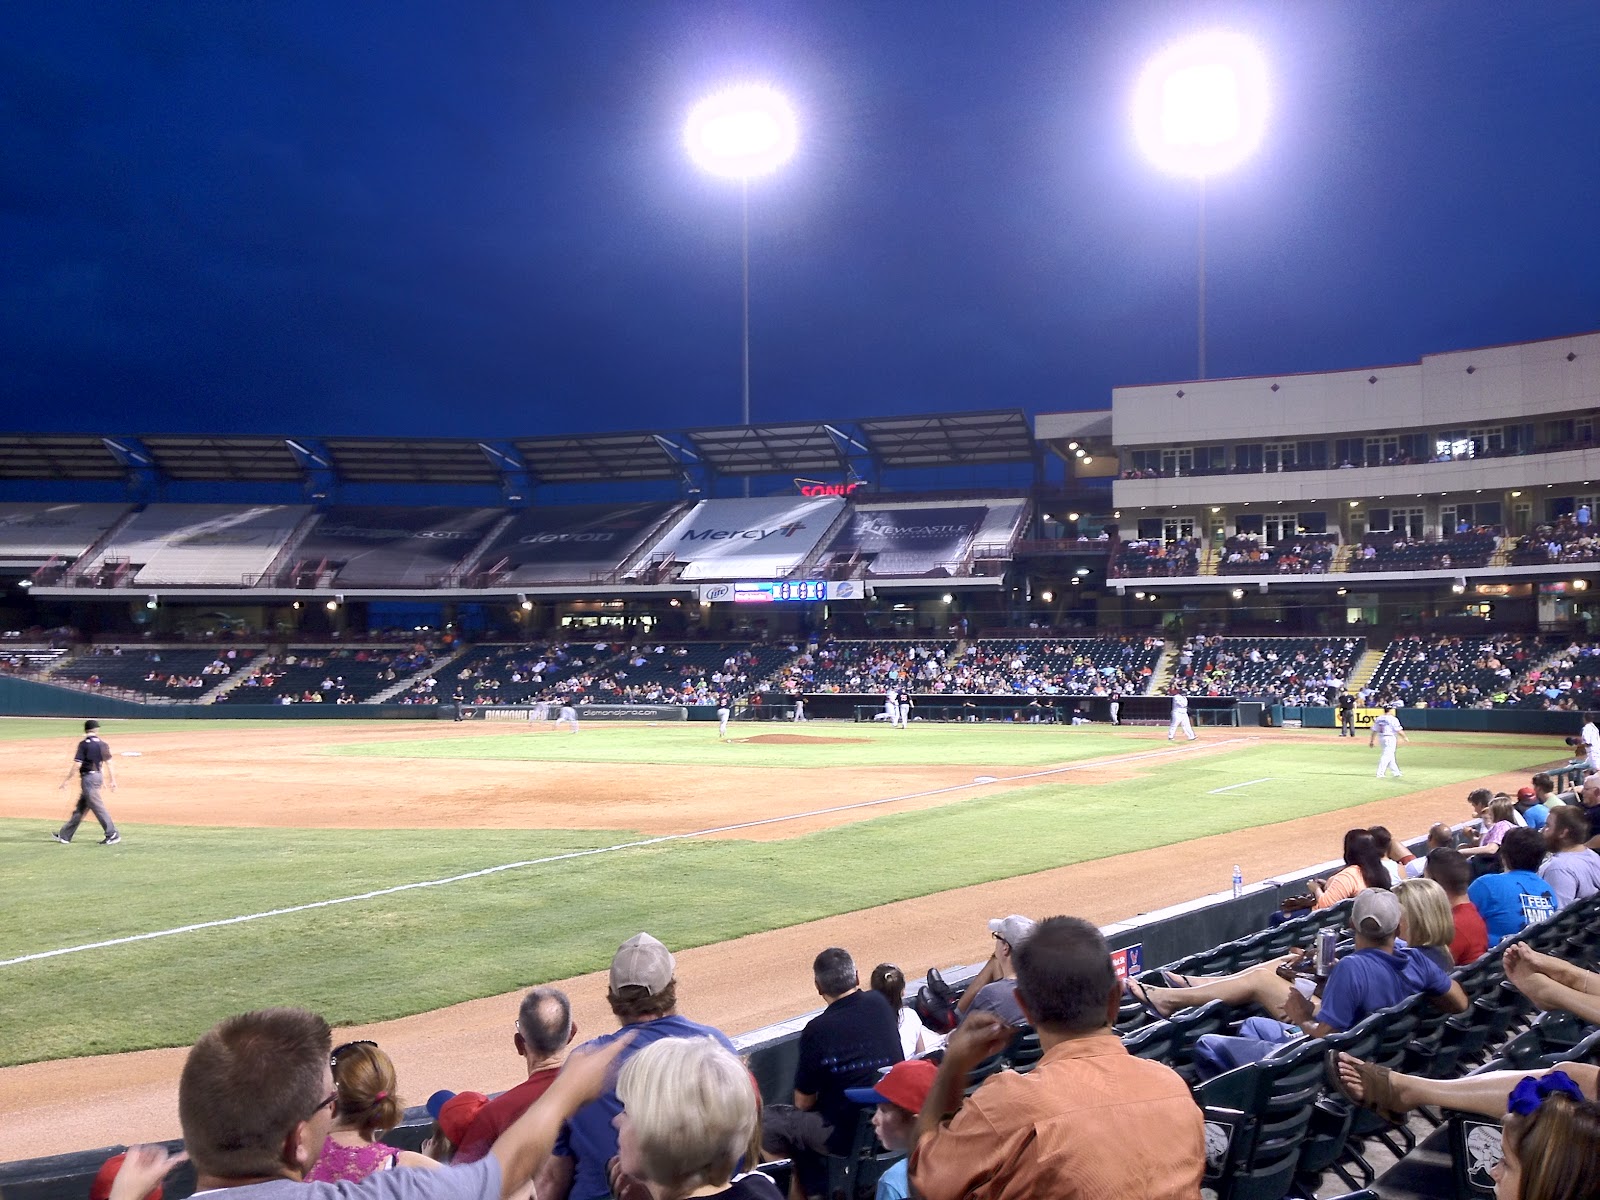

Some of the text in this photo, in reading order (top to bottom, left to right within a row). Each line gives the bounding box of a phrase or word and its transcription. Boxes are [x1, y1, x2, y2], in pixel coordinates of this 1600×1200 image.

[519, 531, 614, 543] devon
[680, 529, 778, 542] Mercy
[485, 710, 528, 720] DIAMOND
[583, 709, 658, 718] diamondpro.com
[1356, 713, 1378, 723] Lov
[1527, 896, 1553, 908] FEEL
